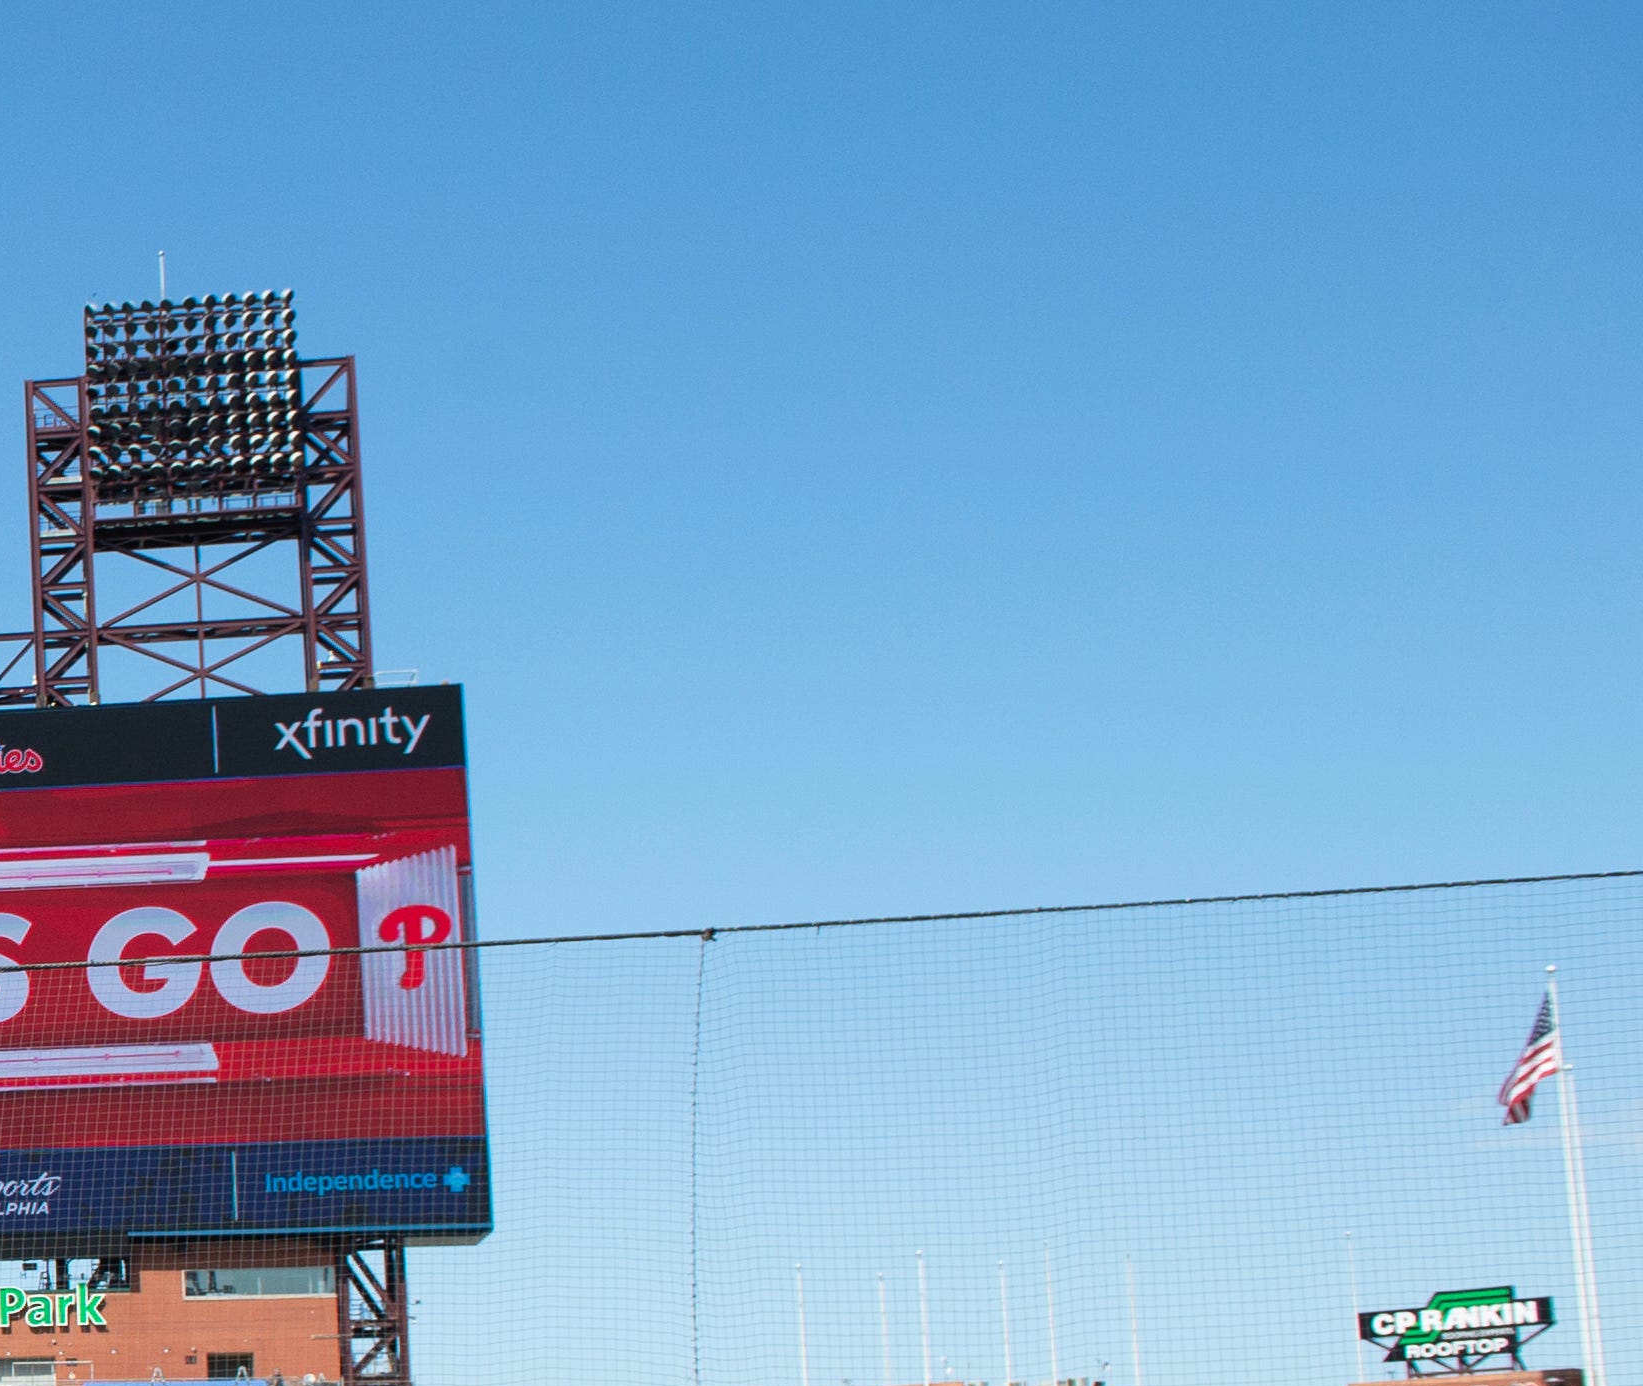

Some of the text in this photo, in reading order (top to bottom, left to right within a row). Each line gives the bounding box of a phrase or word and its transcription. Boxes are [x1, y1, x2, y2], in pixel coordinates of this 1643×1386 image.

[274, 708, 430, 760] xfinity
[86, 900, 332, 1018] GO
[379, 904, 452, 990] P
[265, 1168, 437, 1195] Independence
[1370, 1311, 1416, 1336] CP
[1420, 1300, 1538, 1331] RANKIN
[1405, 1338, 1508, 1359] ROOFTOP
